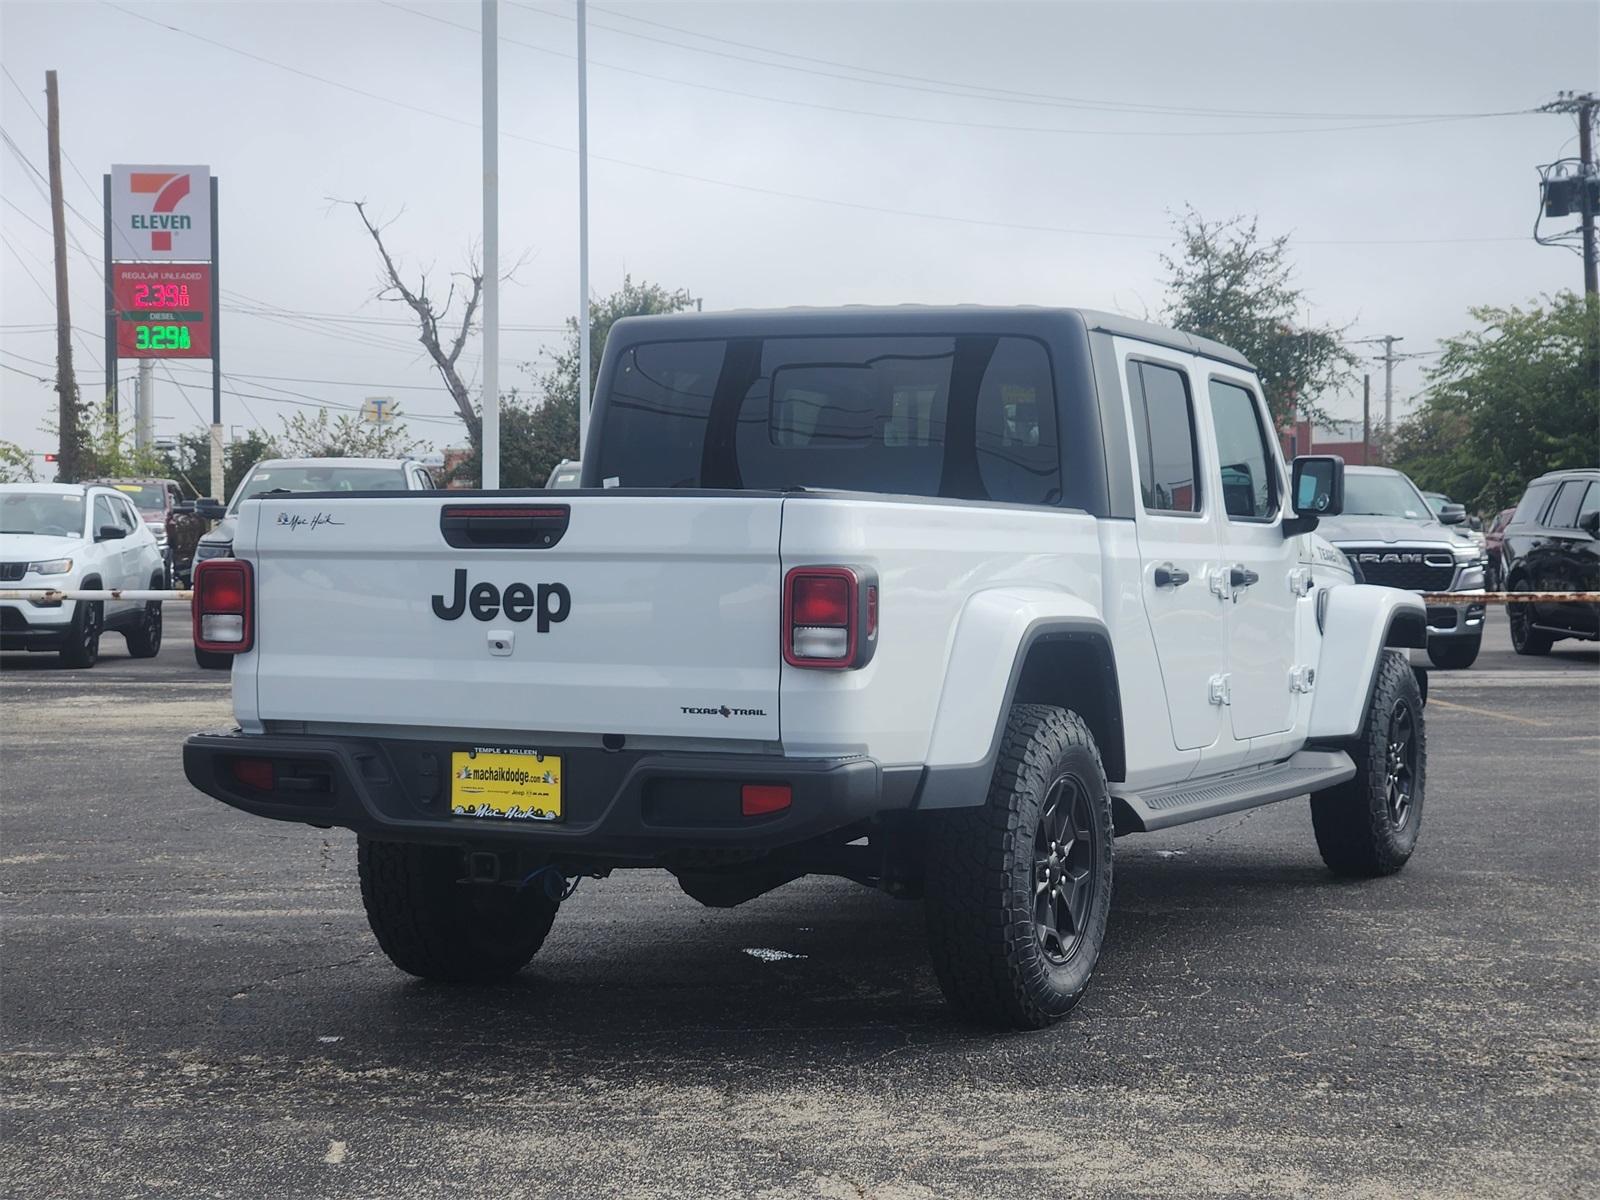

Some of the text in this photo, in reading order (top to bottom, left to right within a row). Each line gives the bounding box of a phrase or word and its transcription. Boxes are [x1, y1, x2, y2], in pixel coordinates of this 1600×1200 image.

[121, 271, 202, 280] REGULAR UNLEADED
[149, 312, 175, 320] DIESEL
[1359, 553, 1422, 564] RAM
[431, 568, 572, 633] Jeep
[680, 706, 767, 716] TEXAS TRAIL
[472, 766, 541, 786] machaikdodge.com
[474, 803, 537, 819] Mac Haik
